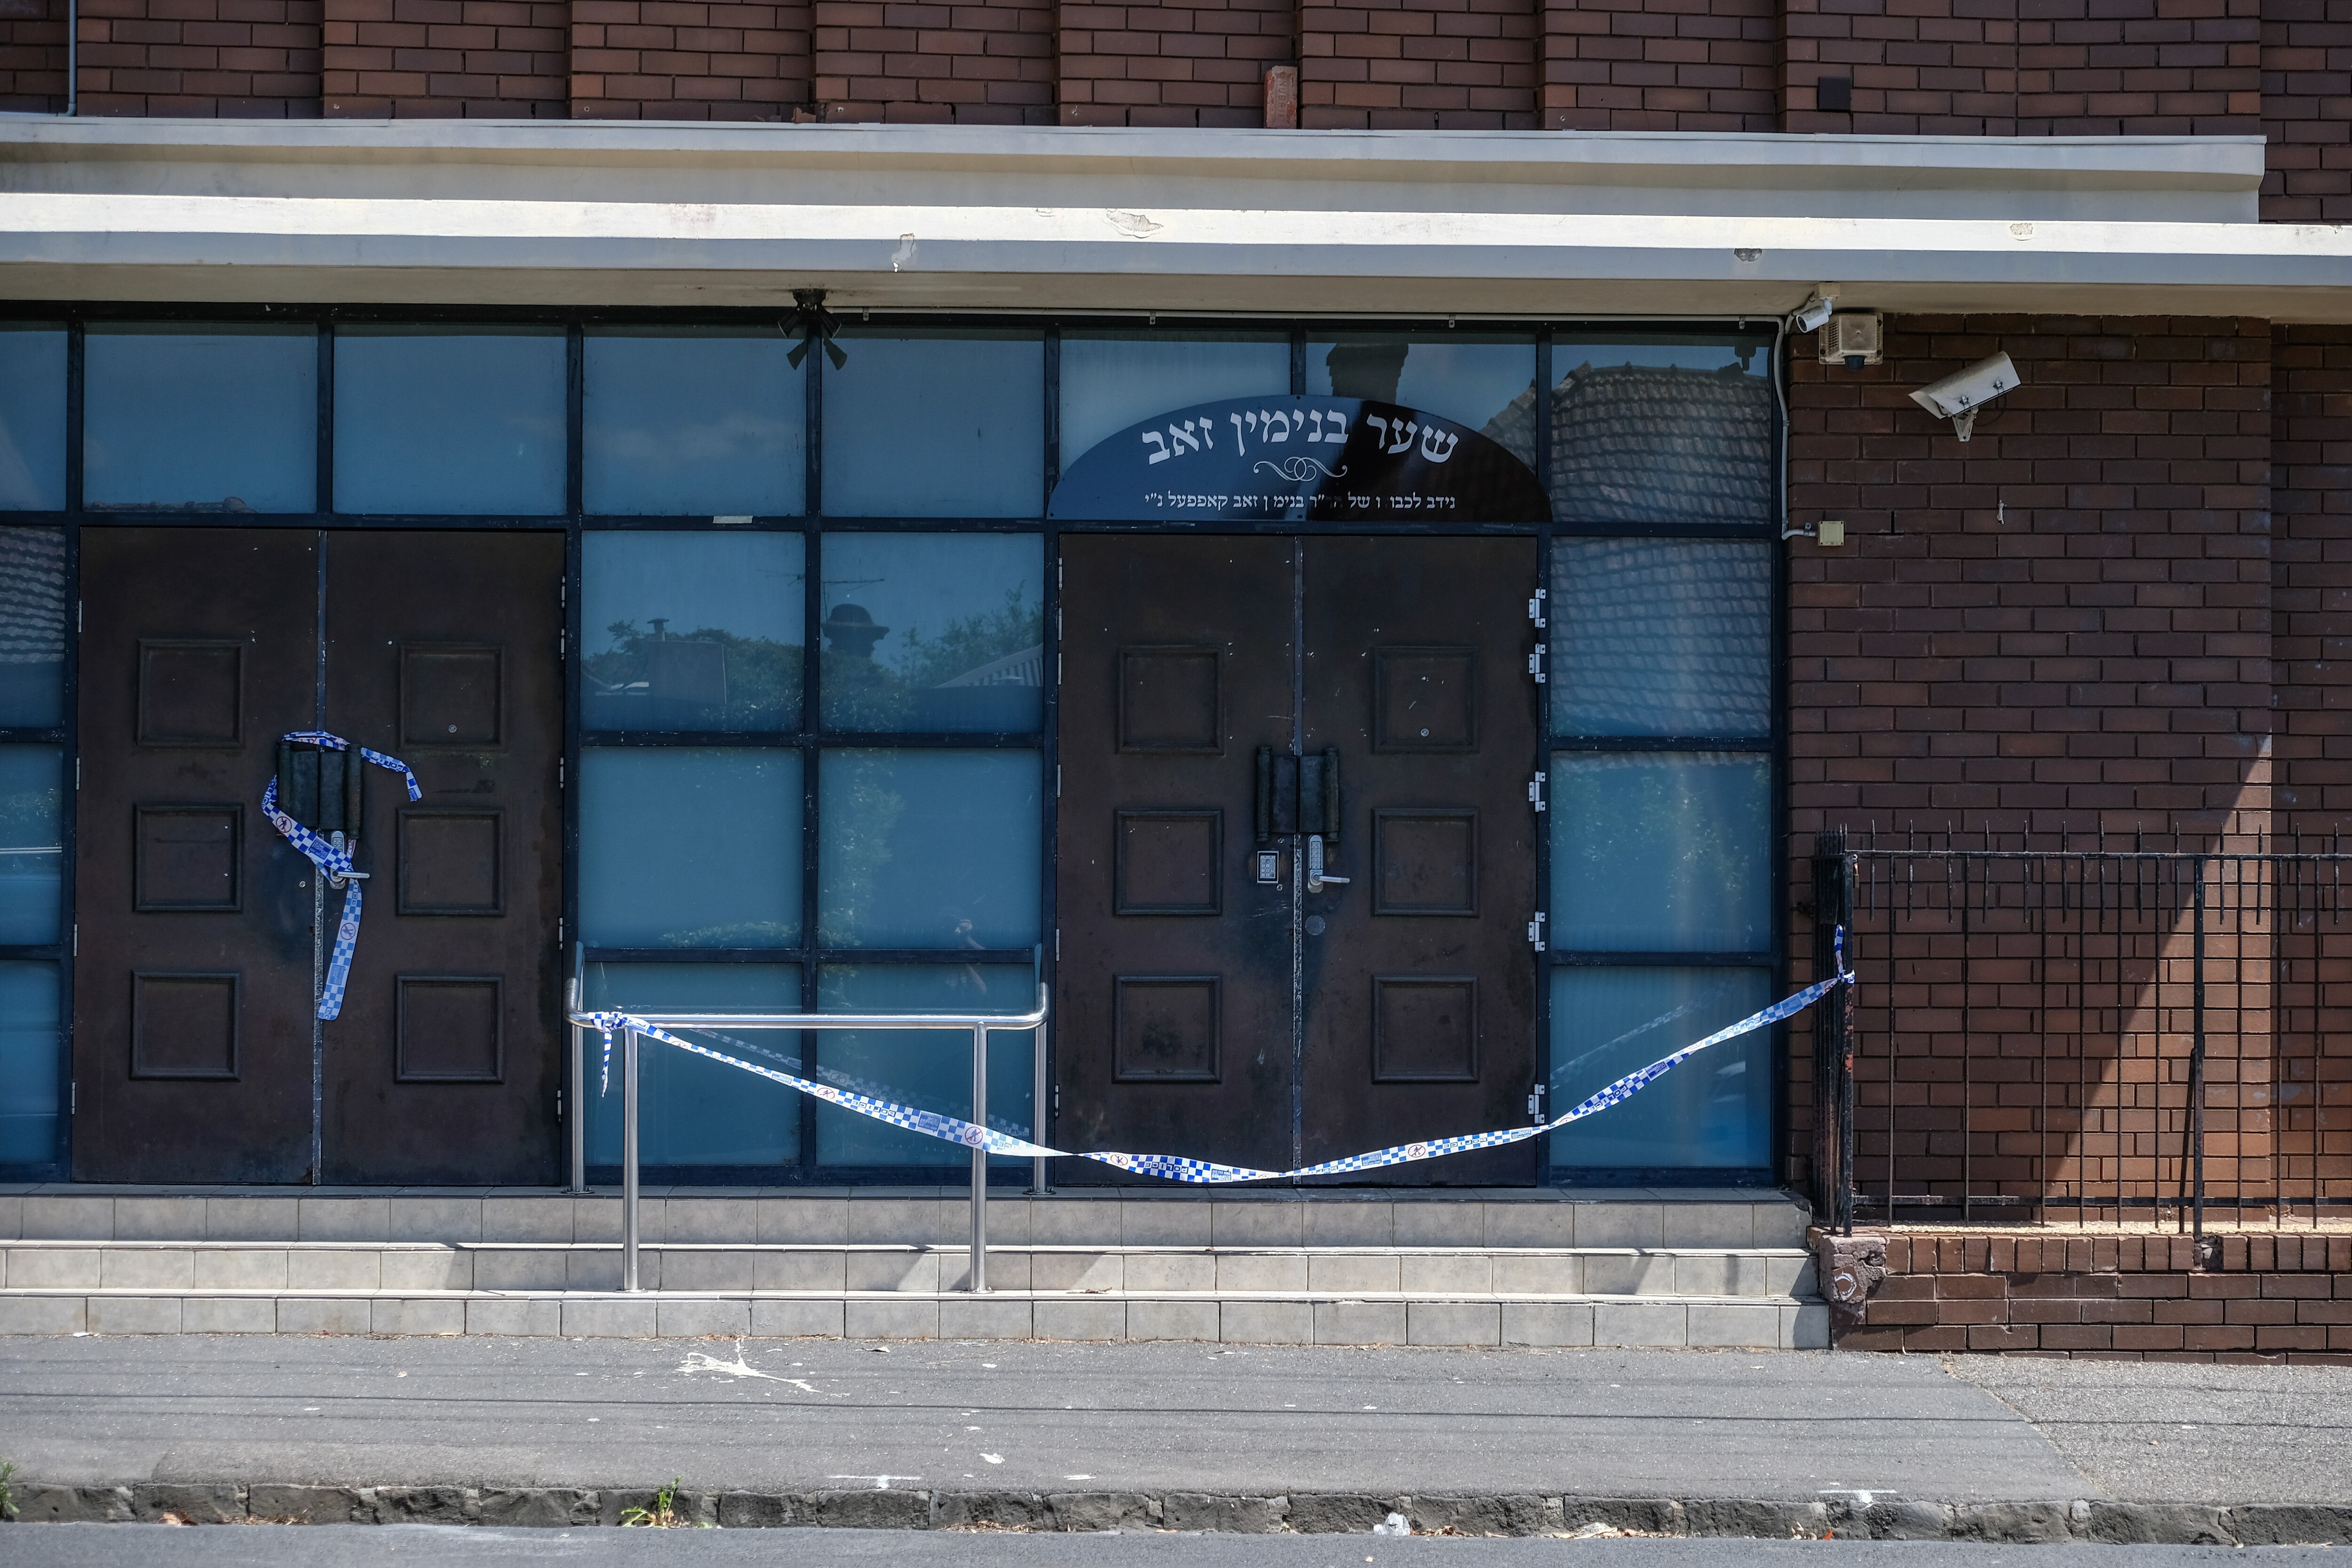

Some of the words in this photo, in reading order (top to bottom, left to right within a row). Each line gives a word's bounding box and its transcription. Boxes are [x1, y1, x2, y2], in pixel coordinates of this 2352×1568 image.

[1142, 416, 1214, 465] זאב
[1230, 408, 1349, 457] בנימין
[1367, 414, 1459, 463] שער
[1168, 490, 1228, 511] קאפפעל
[1233, 495, 1258, 508] זאב
[1263, 495, 1304, 511] בנימן
[1348, 491, 1371, 509] של
[1376, 491, 1422, 509] לכבוו
[1427, 496, 1456, 509] נידב
[1144, 1162, 1188, 1174] POLICE
